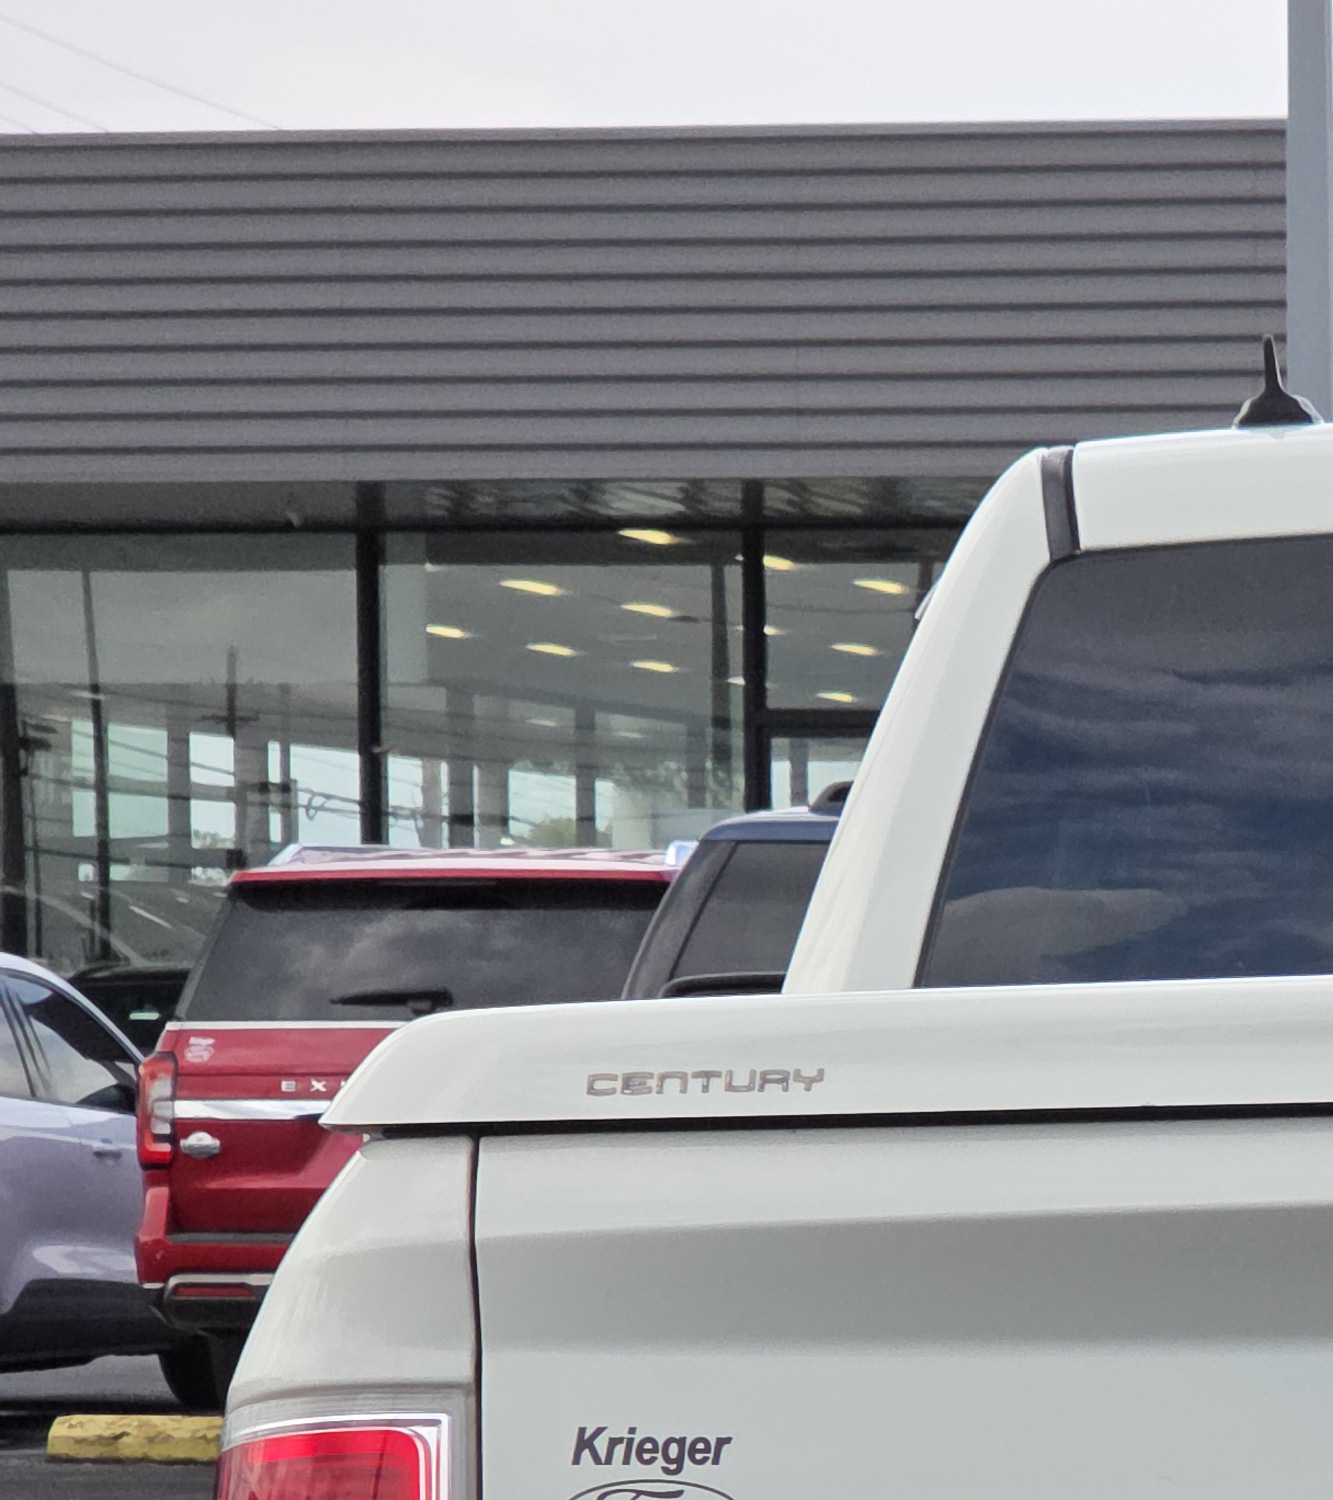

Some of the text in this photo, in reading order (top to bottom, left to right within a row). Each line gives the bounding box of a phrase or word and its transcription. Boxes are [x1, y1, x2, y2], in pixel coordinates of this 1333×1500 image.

[281, 1078, 347, 1092] EX
[586, 1067, 825, 1096] CENTURY
[571, 1426, 733, 1476] Krieger
